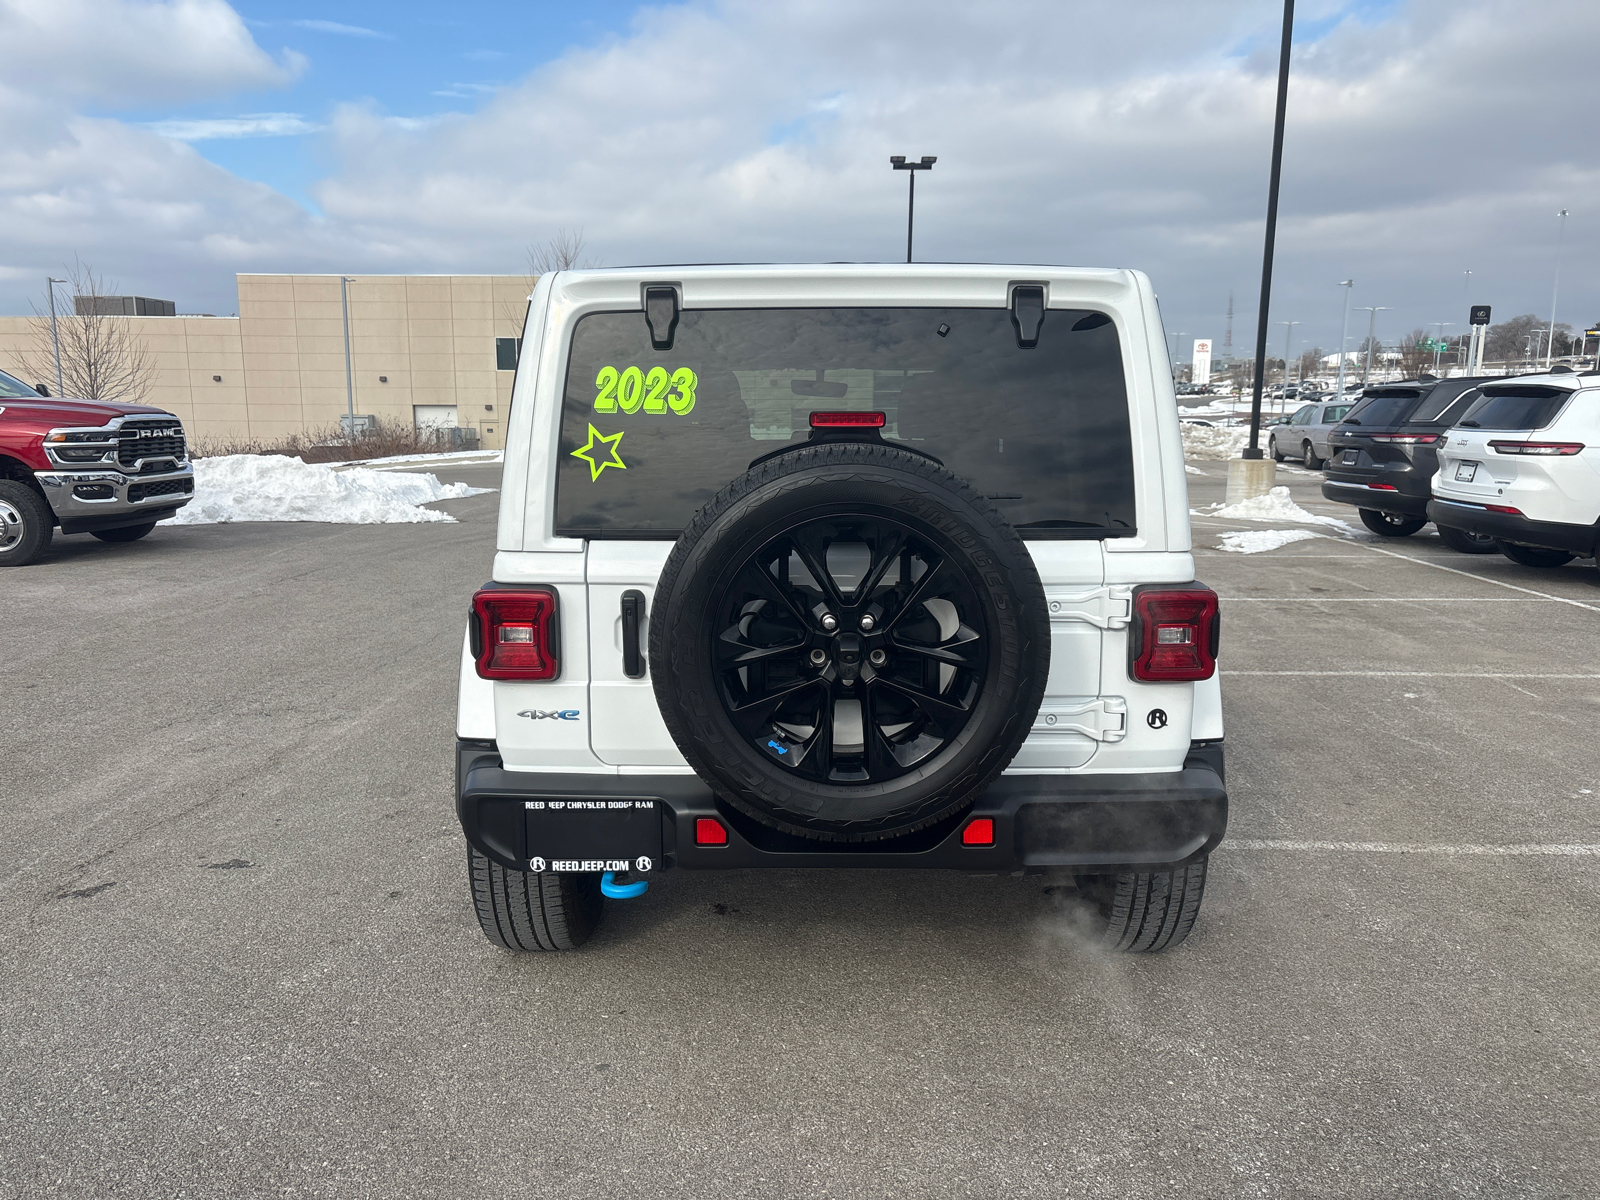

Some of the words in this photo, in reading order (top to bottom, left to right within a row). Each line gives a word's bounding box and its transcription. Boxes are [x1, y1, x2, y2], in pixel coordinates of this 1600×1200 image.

[593, 365, 698, 416] 2023
[139, 428, 173, 438] RAM
[525, 801, 545, 809] REED
[567, 801, 606, 809] CHRYSLER
[635, 801, 653, 809] RAM
[552, 860, 629, 871] REEDJEEP.COM
